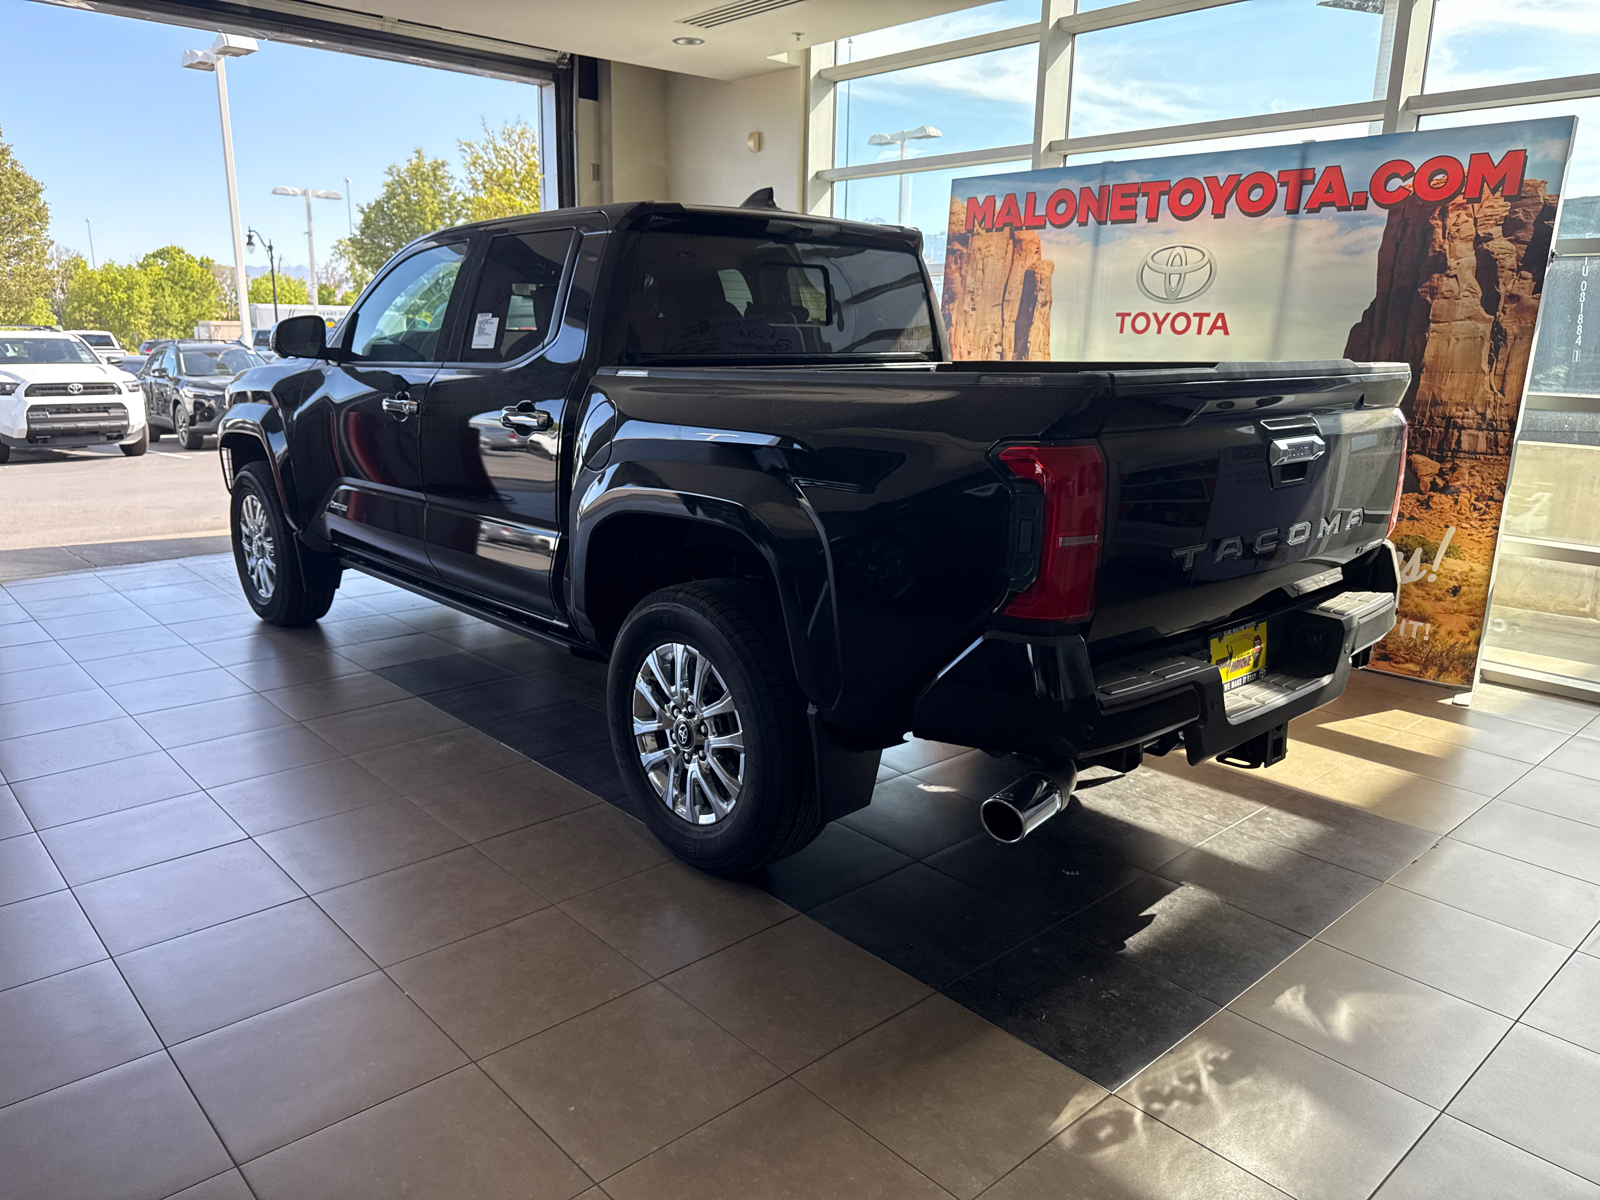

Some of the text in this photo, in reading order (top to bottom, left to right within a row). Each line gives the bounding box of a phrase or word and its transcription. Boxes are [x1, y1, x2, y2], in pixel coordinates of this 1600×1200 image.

[964, 149, 1528, 233] MALONETOYOTA.COM
[1115, 311, 1230, 336] TOYOTA
[1172, 507, 1364, 571] TACOMA
[1399, 619, 1431, 641] IT!
